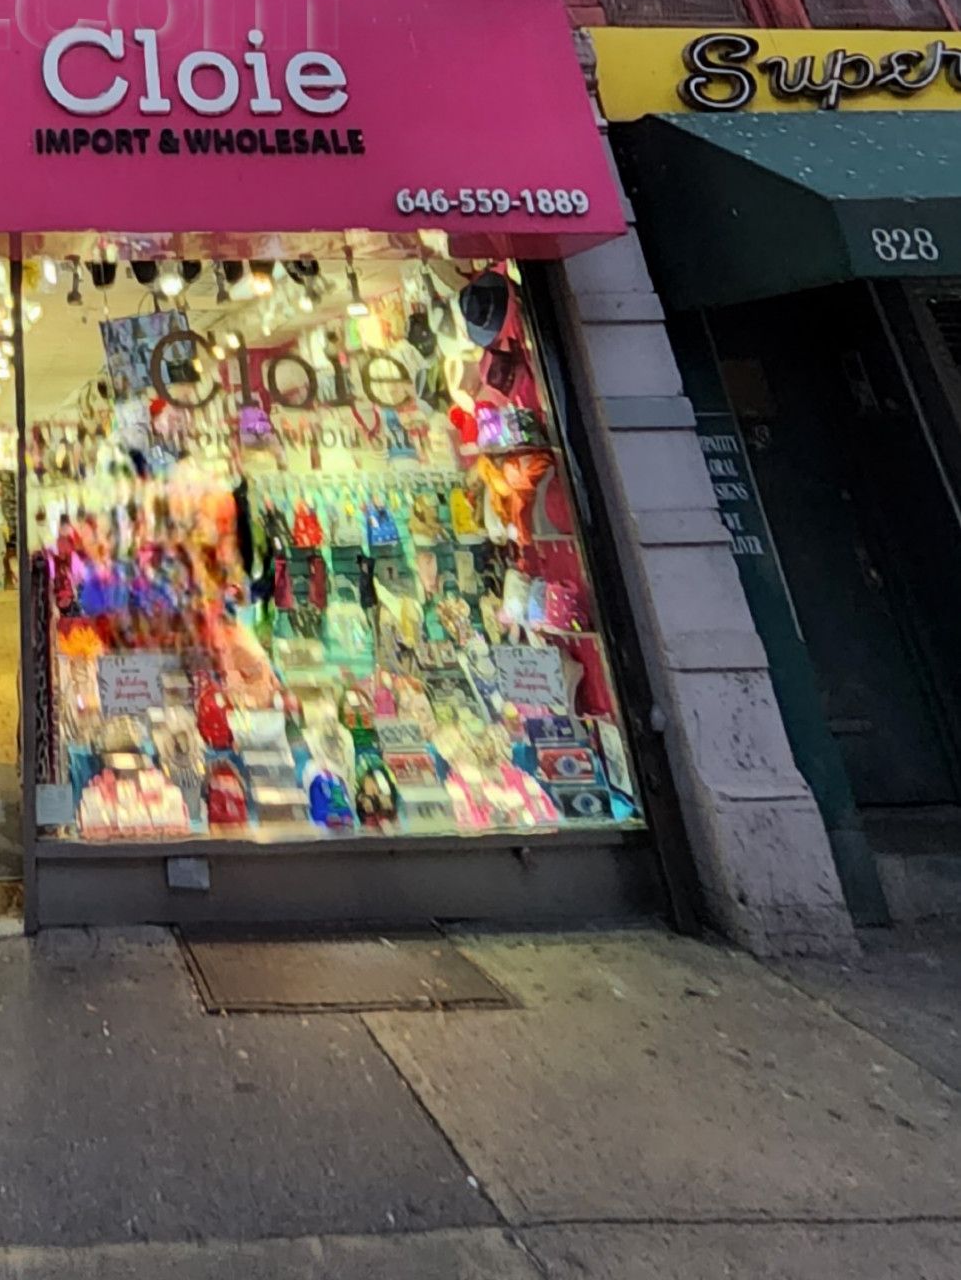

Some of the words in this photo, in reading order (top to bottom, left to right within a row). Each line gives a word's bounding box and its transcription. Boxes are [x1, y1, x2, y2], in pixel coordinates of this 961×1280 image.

[42, 26, 350, 117] Cloie
[35, 128, 151, 155] IMPORT
[158, 128, 181, 155] &
[183, 128, 367, 156] WHOLESALE
[396, 187, 590, 216] 646-559-1889
[872, 227, 939, 261] 828
